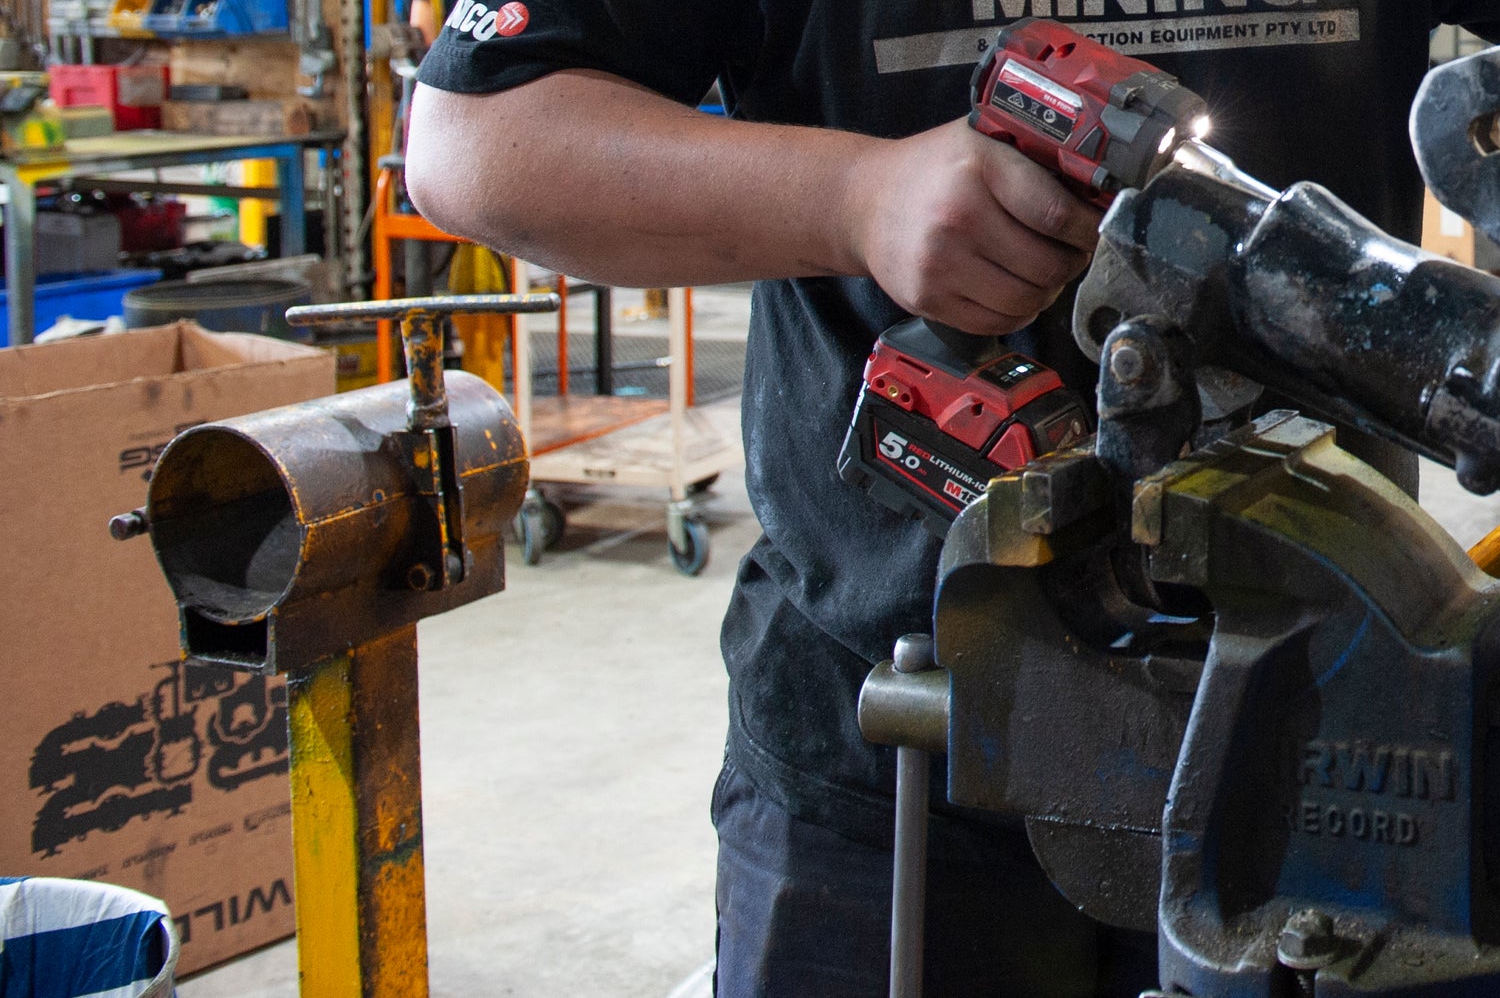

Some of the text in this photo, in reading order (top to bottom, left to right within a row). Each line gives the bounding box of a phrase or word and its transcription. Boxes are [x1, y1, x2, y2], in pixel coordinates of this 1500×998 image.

[977, 38, 989, 53] &
[1150, 23, 1259, 45] EQUIPMENT
[1265, 21, 1303, 37] PTY
[1307, 19, 1337, 36] LTD
[878, 430, 921, 470] 5.0
[907, 442, 987, 492] REDLITHIUM-IO
[1299, 739, 1458, 802] RWIN
